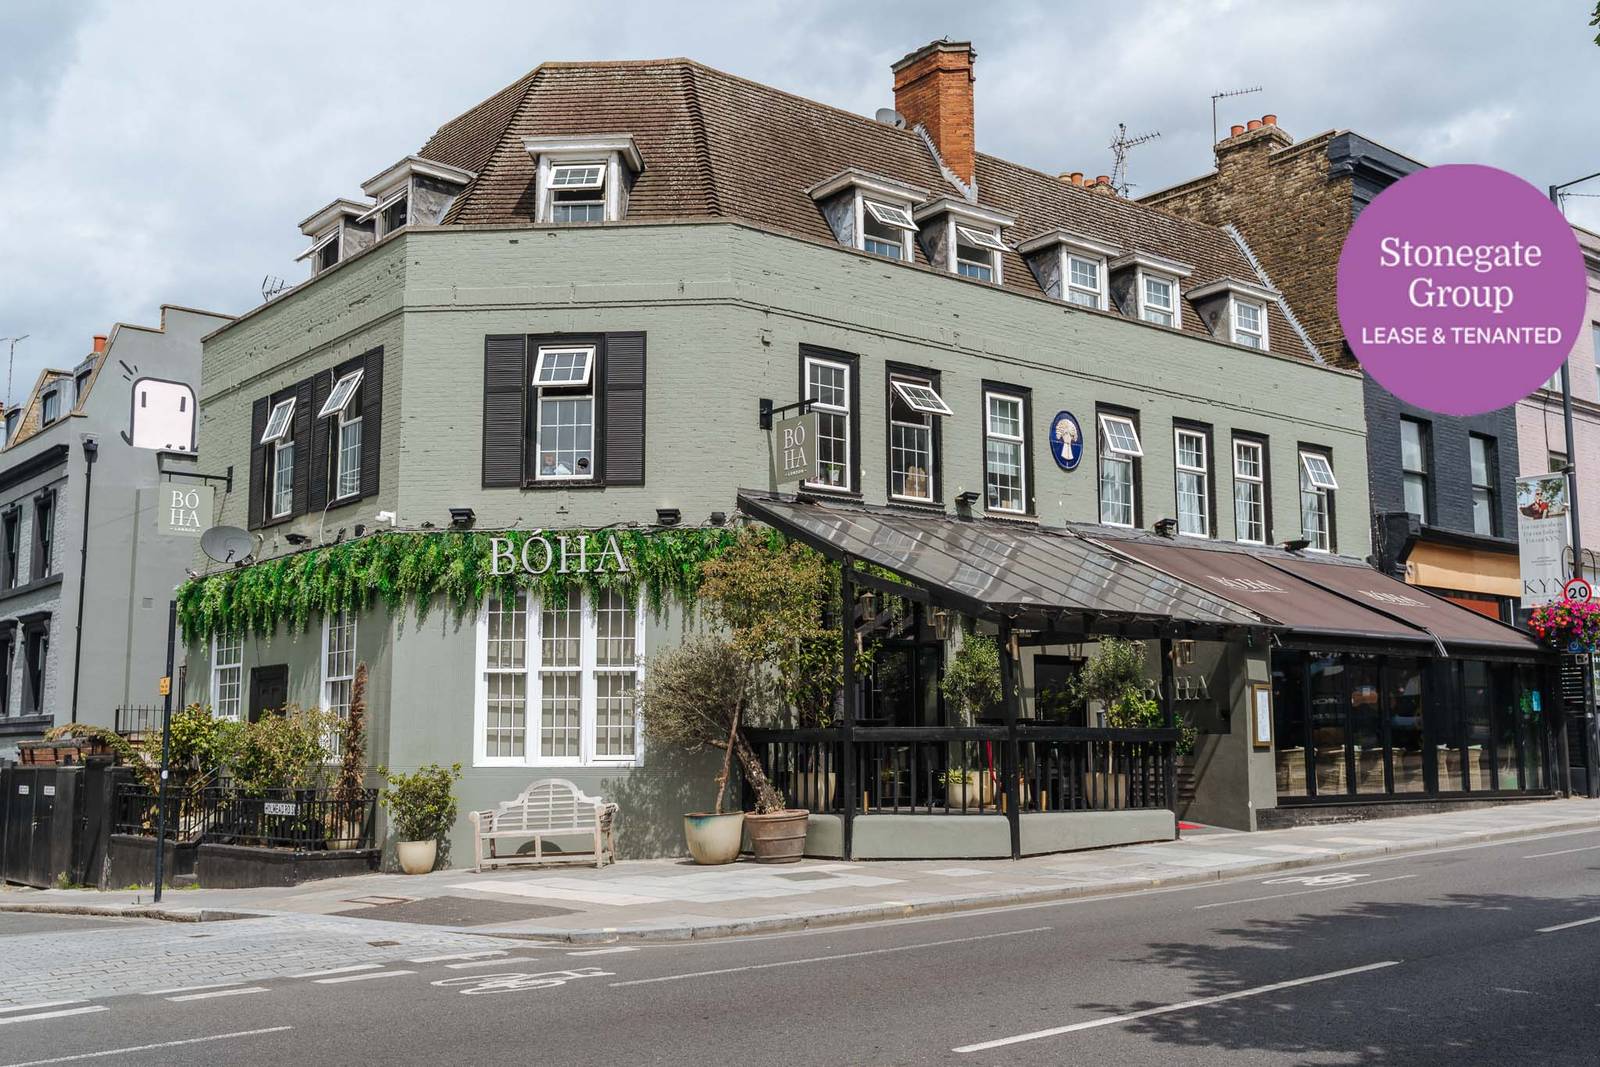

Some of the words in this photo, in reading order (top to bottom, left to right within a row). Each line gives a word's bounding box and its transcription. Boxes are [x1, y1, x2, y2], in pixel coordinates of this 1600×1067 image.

[784, 421, 805, 450] BÓ
[784, 446, 808, 471] HA
[171, 489, 200, 509] BÓ
[170, 508, 201, 528] HA
[489, 528, 630, 576] BÓHA
[1568, 586, 1588, 599] 20
